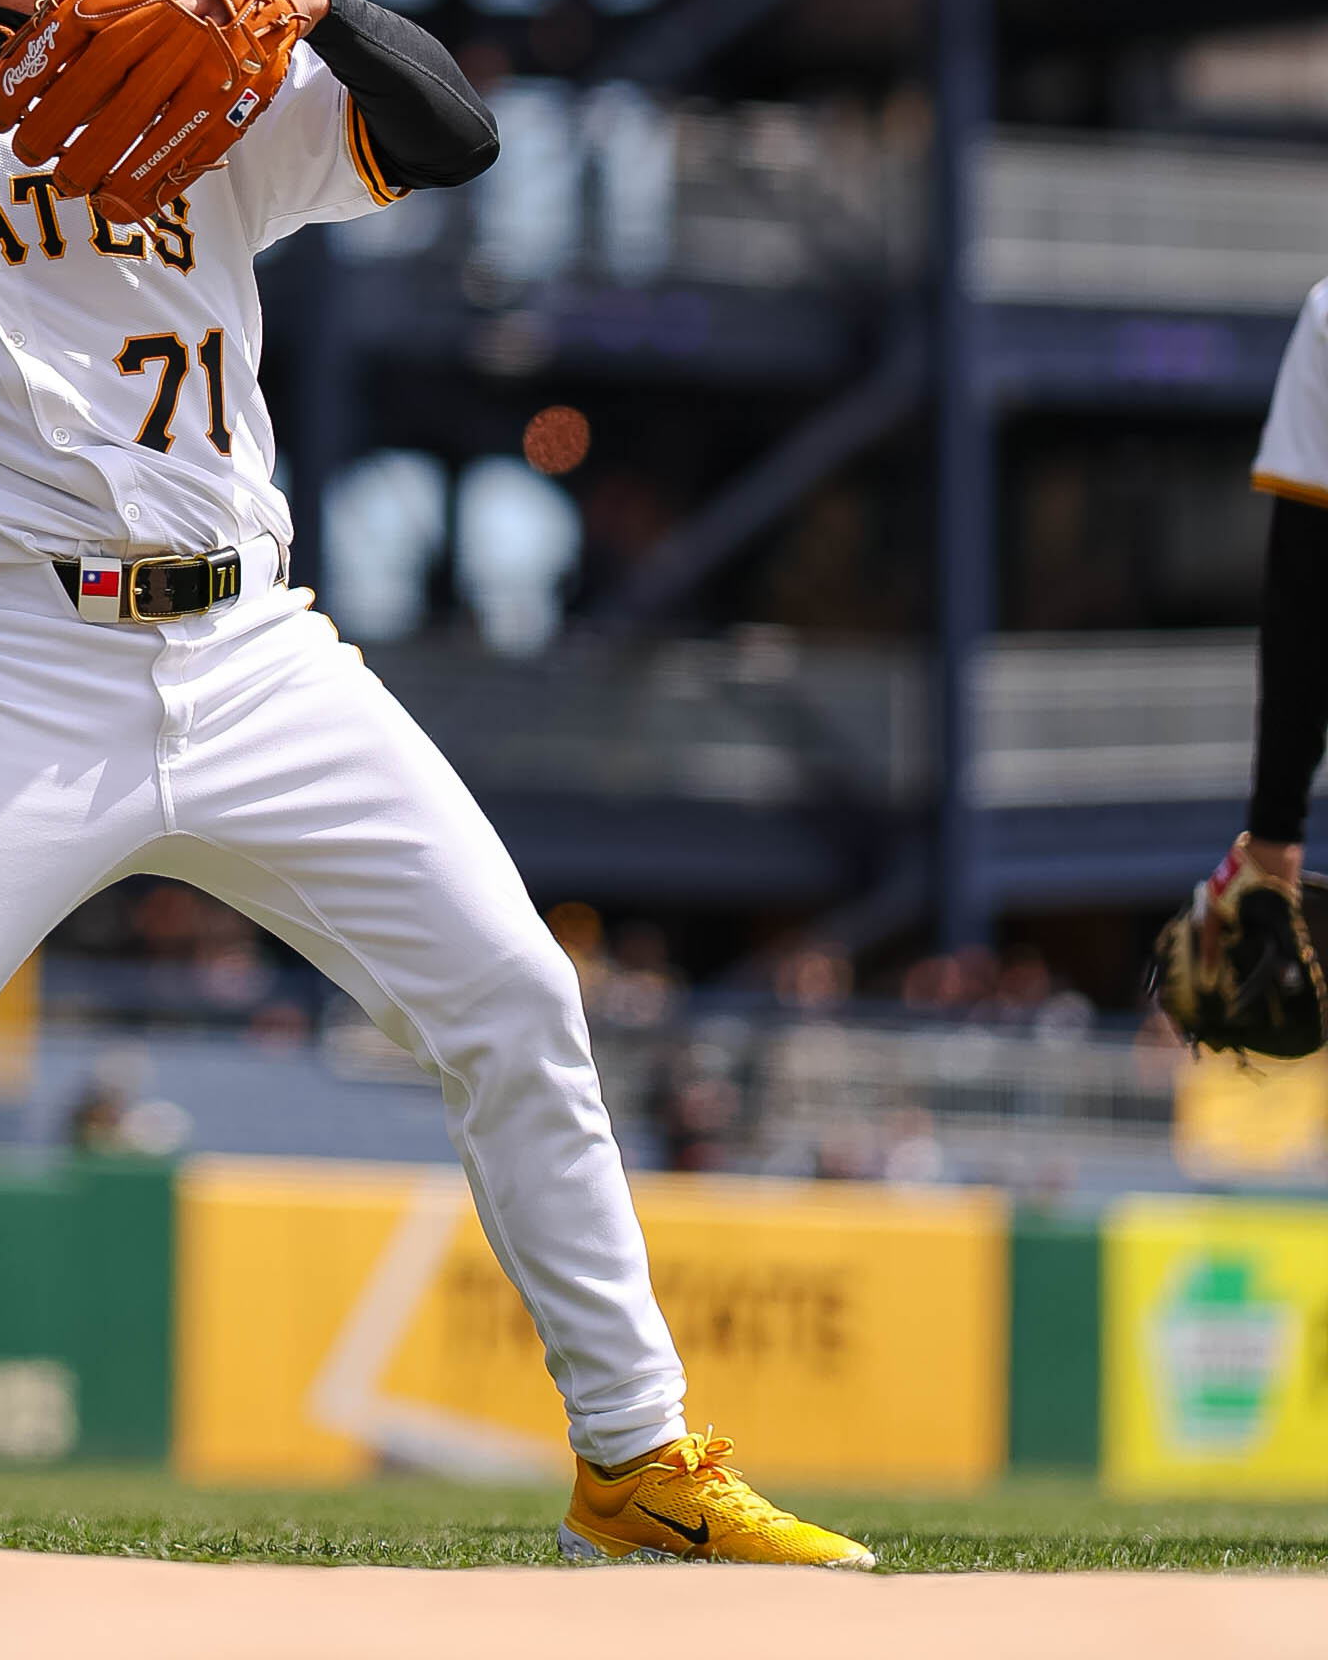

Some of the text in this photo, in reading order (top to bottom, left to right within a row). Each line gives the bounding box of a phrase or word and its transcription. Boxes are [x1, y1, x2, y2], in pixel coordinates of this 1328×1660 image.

[2, 21, 60, 97] Rawlings
[131, 109, 211, 181] THE GOLD GLOVE CO.
[112, 327, 232, 458] 71
[216, 564, 236, 598] 71
